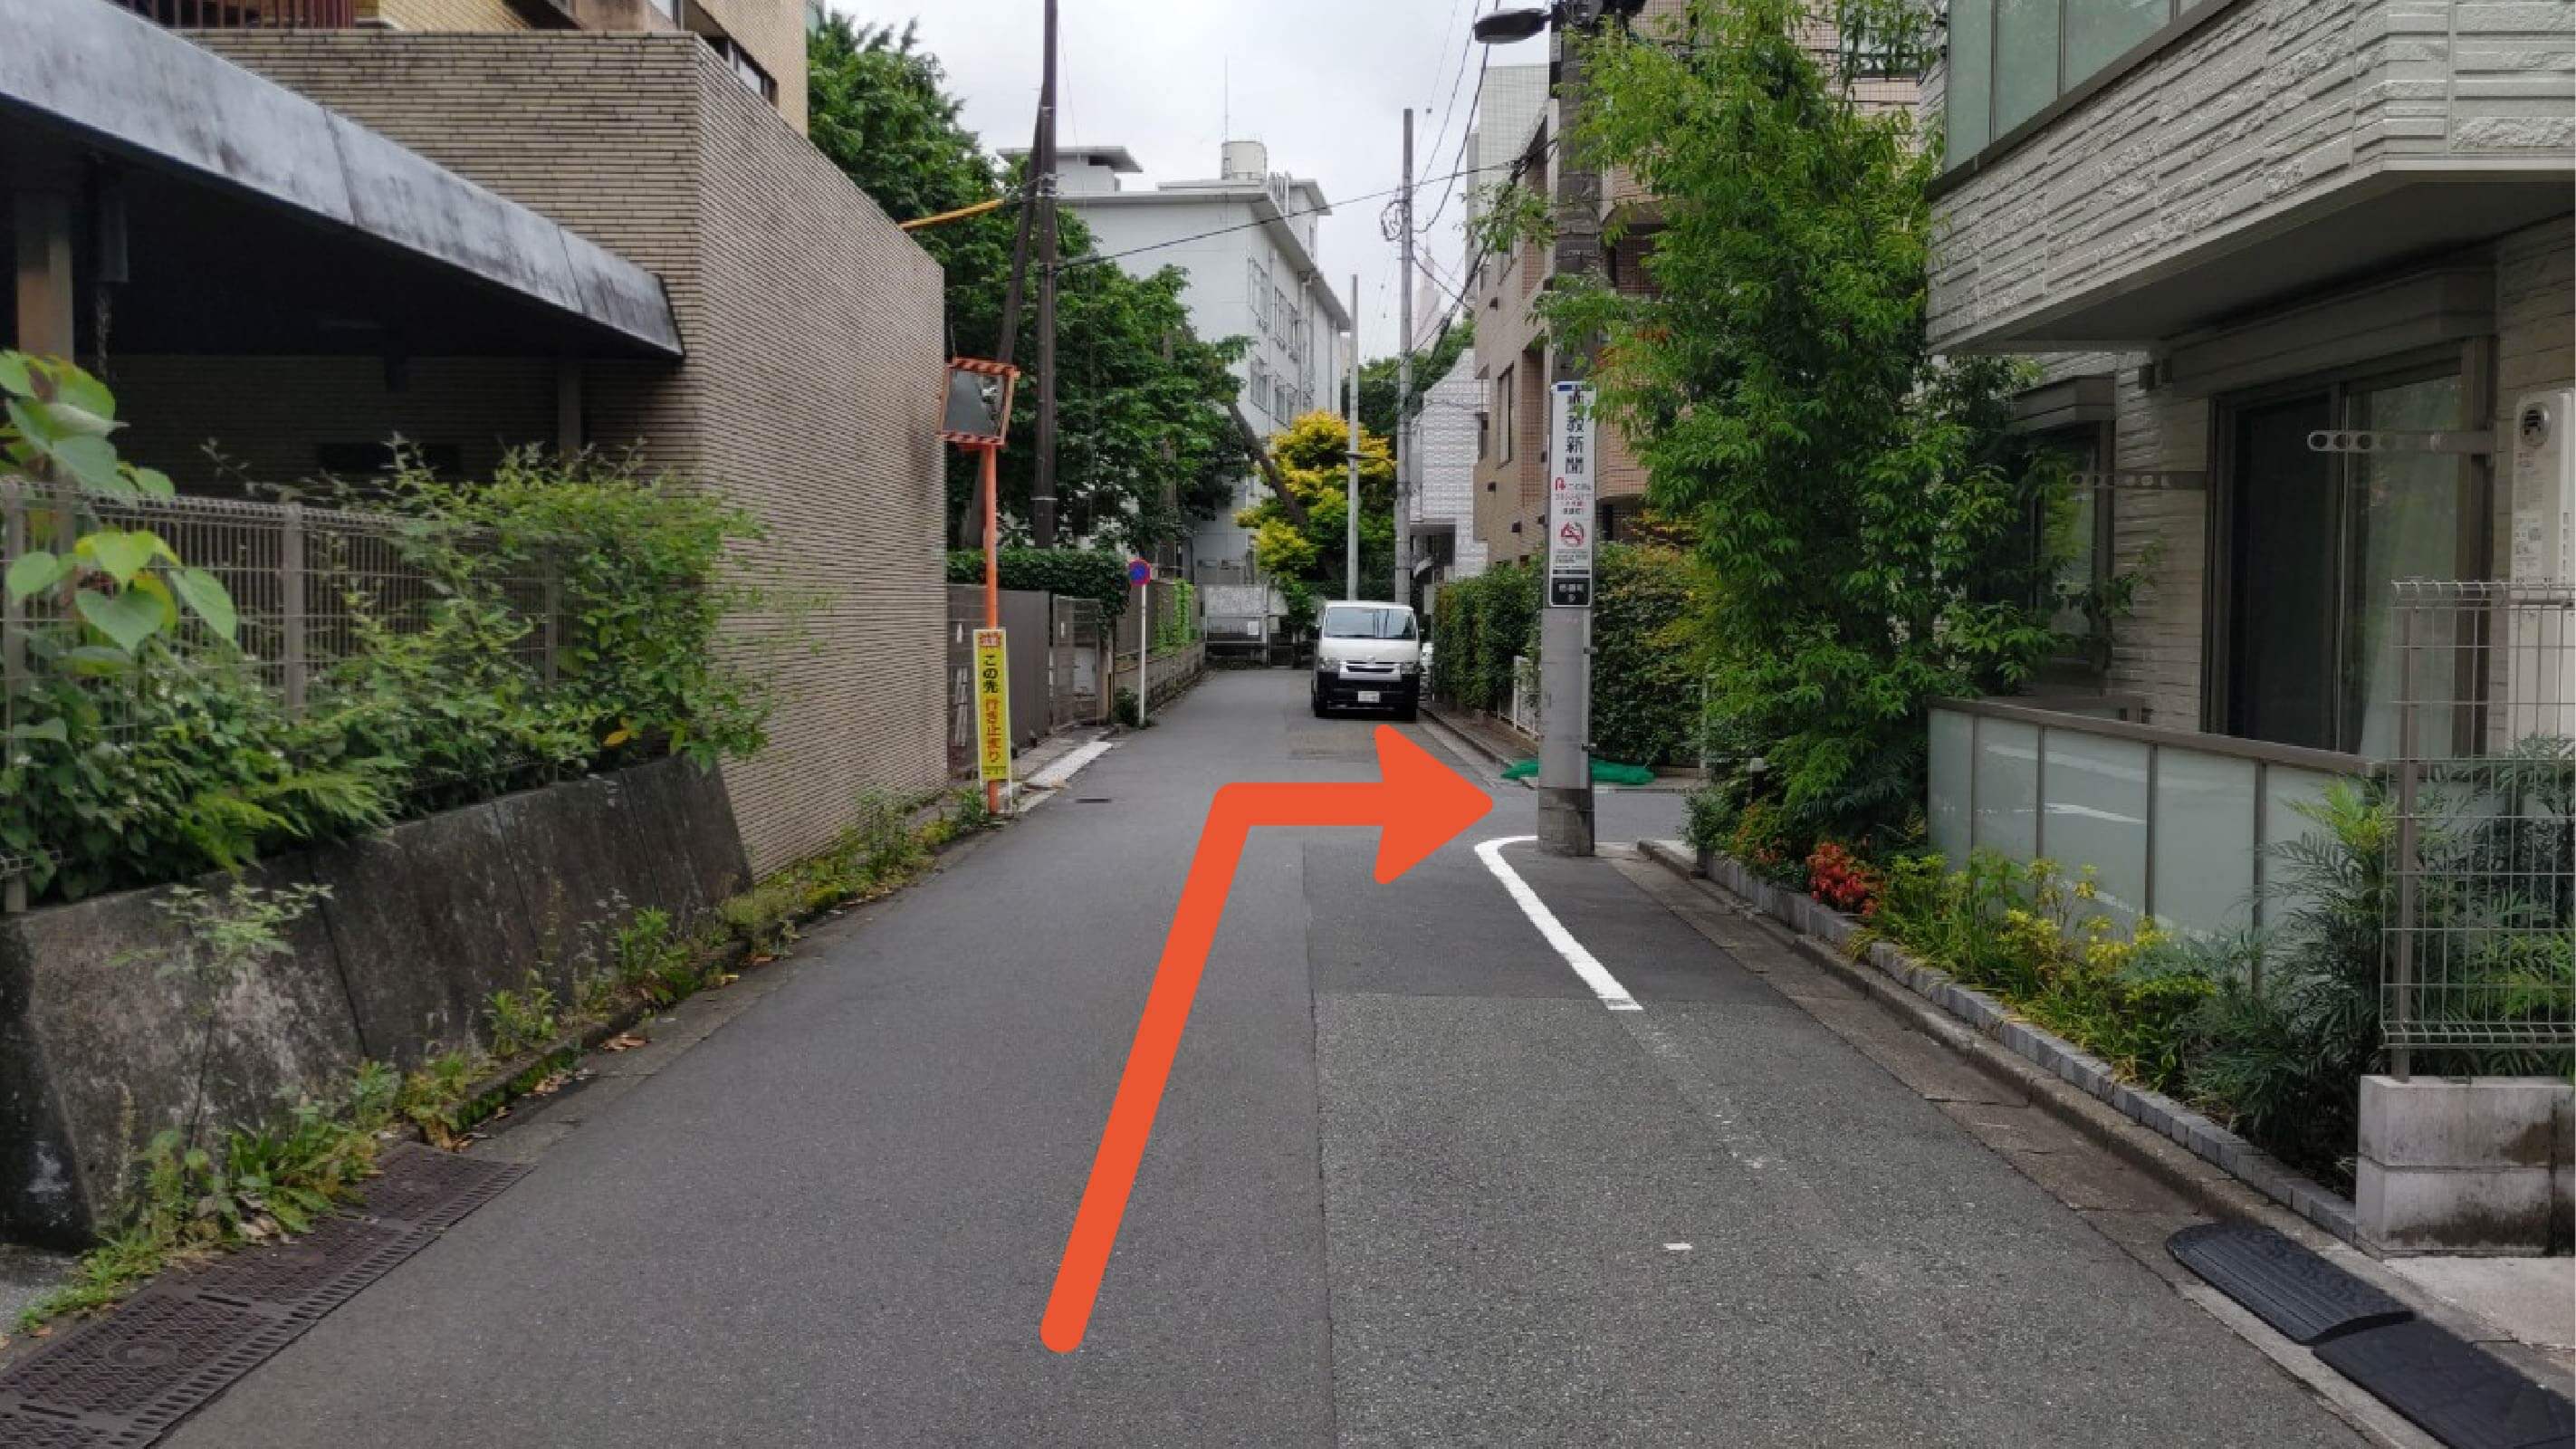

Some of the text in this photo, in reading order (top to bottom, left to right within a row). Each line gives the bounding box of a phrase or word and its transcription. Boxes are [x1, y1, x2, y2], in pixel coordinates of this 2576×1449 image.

[982, 655, 1000, 694] この先
[986, 698, 1001, 763] 行き止まり
